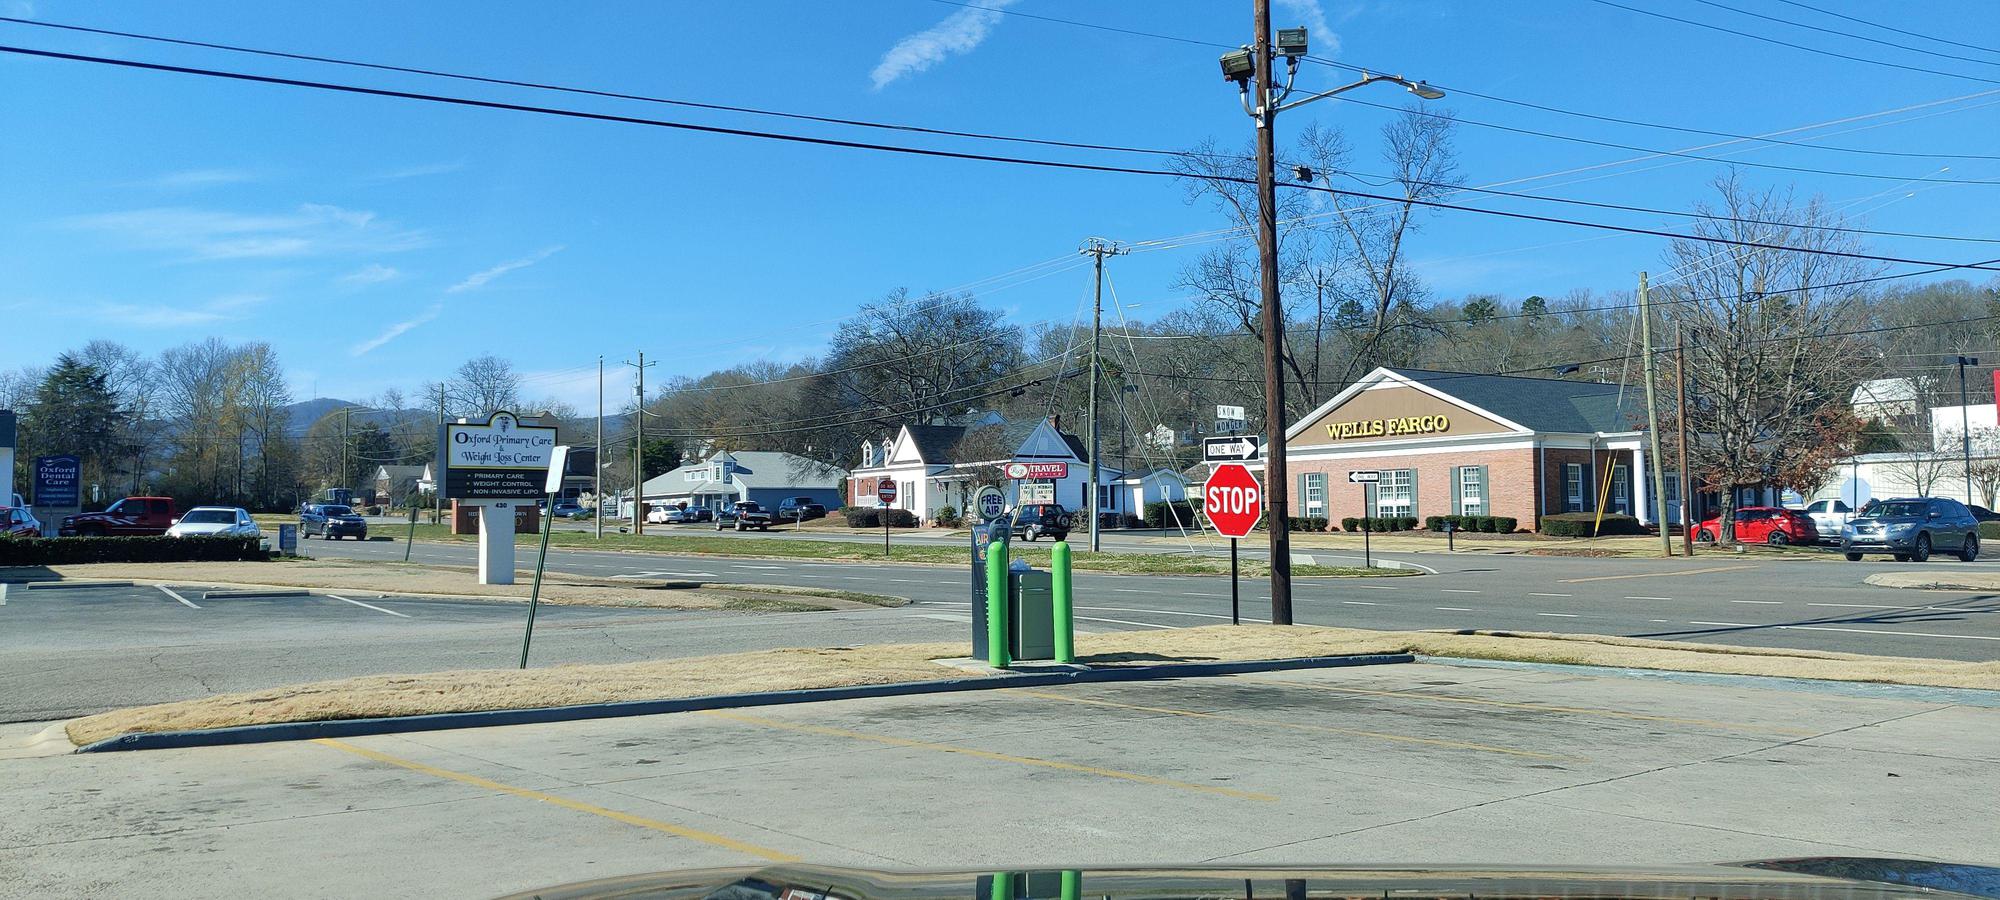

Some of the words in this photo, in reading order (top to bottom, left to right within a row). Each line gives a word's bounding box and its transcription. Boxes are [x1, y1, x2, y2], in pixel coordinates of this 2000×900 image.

[1326, 420, 1385, 439] WELLS
[1387, 415, 1449, 435] FARGO
[455, 432, 491, 447] Oxford
[493, 434, 530, 448] Primary
[531, 436, 552, 446] Care
[1210, 445, 1226, 454] ONE
[1230, 443, 1245, 453] WAY
[461, 452, 492, 464] Weight
[494, 452, 512, 464] Loss
[513, 453, 541, 462] Center
[1030, 464, 1062, 472] TRAVEL
[981, 494, 1003, 505] FREE
[1209, 486, 1257, 514] STOP
[985, 506, 999, 515] AIR
